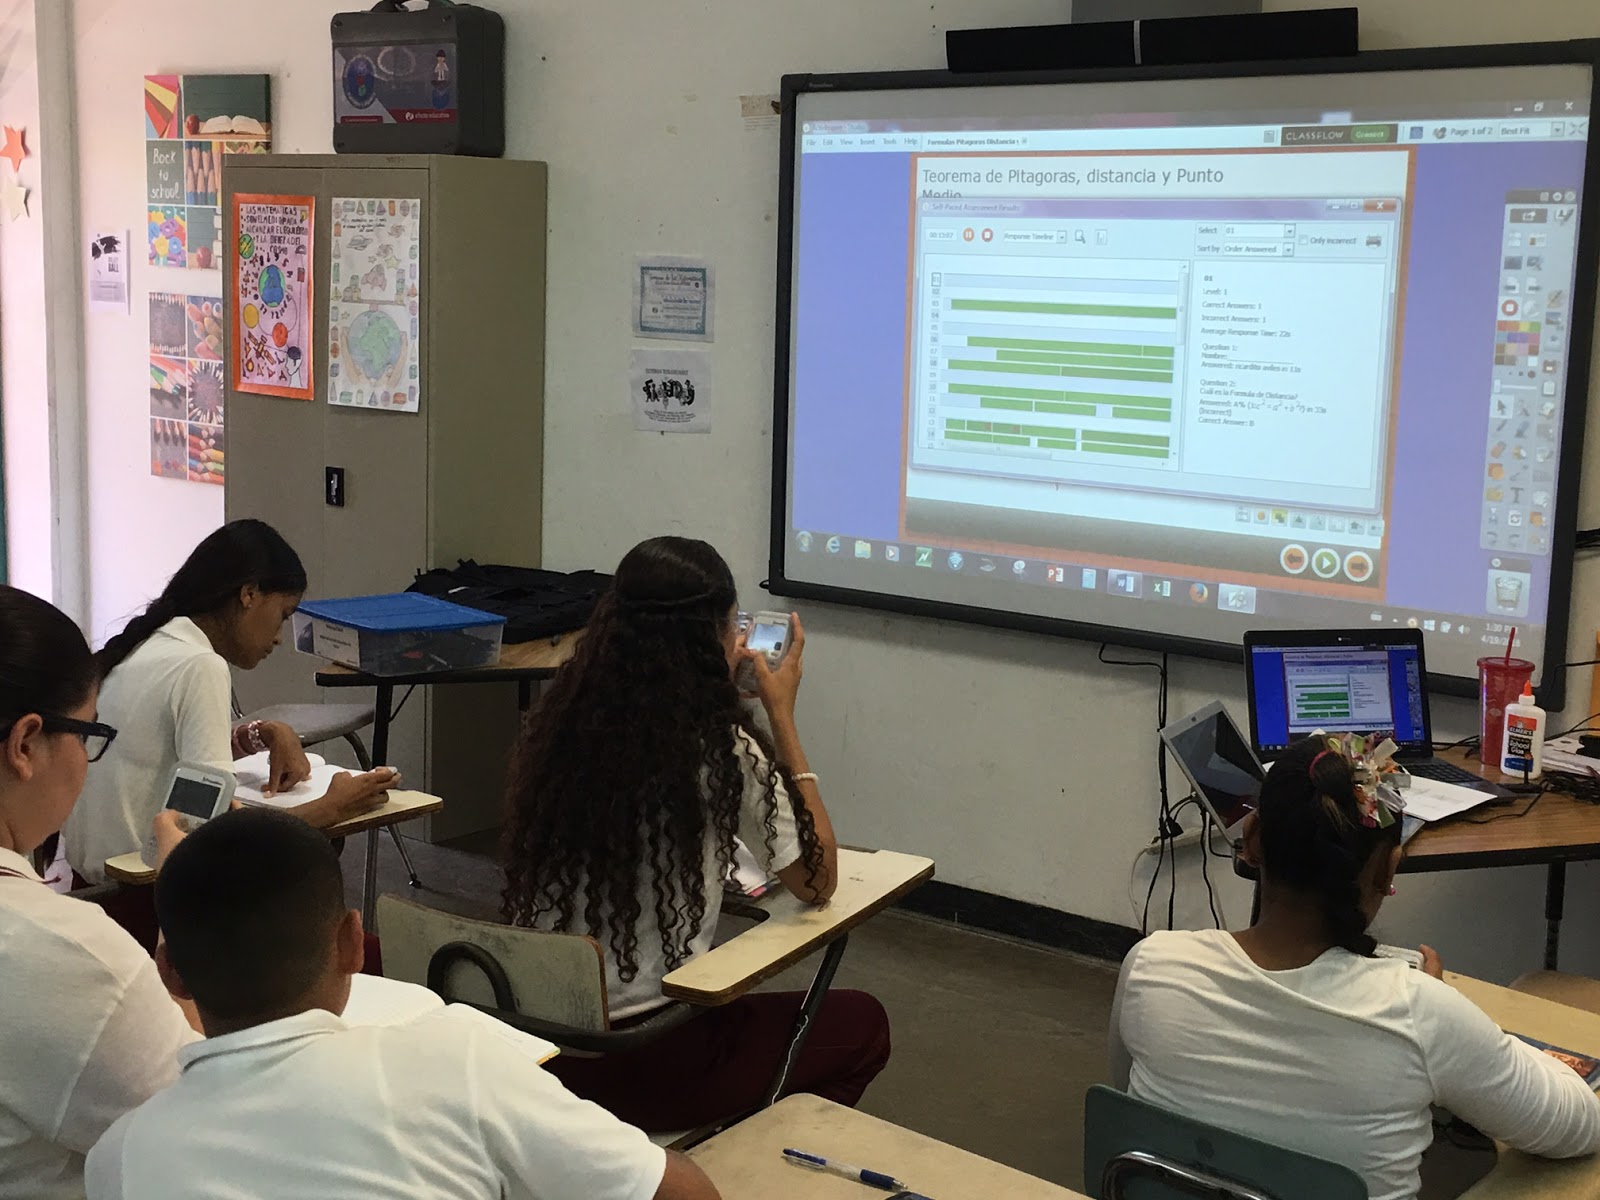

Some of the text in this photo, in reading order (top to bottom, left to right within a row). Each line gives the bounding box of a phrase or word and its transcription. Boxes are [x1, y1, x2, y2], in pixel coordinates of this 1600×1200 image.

[1451, 127, 1469, 136] Page
[1501, 126, 1530, 135] Best Fit
[1286, 131, 1344, 140] CLASSFLOW
[806, 138, 815, 146] File
[822, 138, 833, 146] Edit
[904, 137, 917, 146] Help
[153, 148, 176, 164] Back
[159, 170, 168, 181] to
[923, 168, 1224, 186] Teorema de Pitagoras, distancia y Punto
[152, 182, 180, 199] school
[246, 206, 256, 214] LAS
[108, 263, 119, 272] BALL
[1202, 343, 1230, 351] Question
[1510, 740, 1530, 749] School
